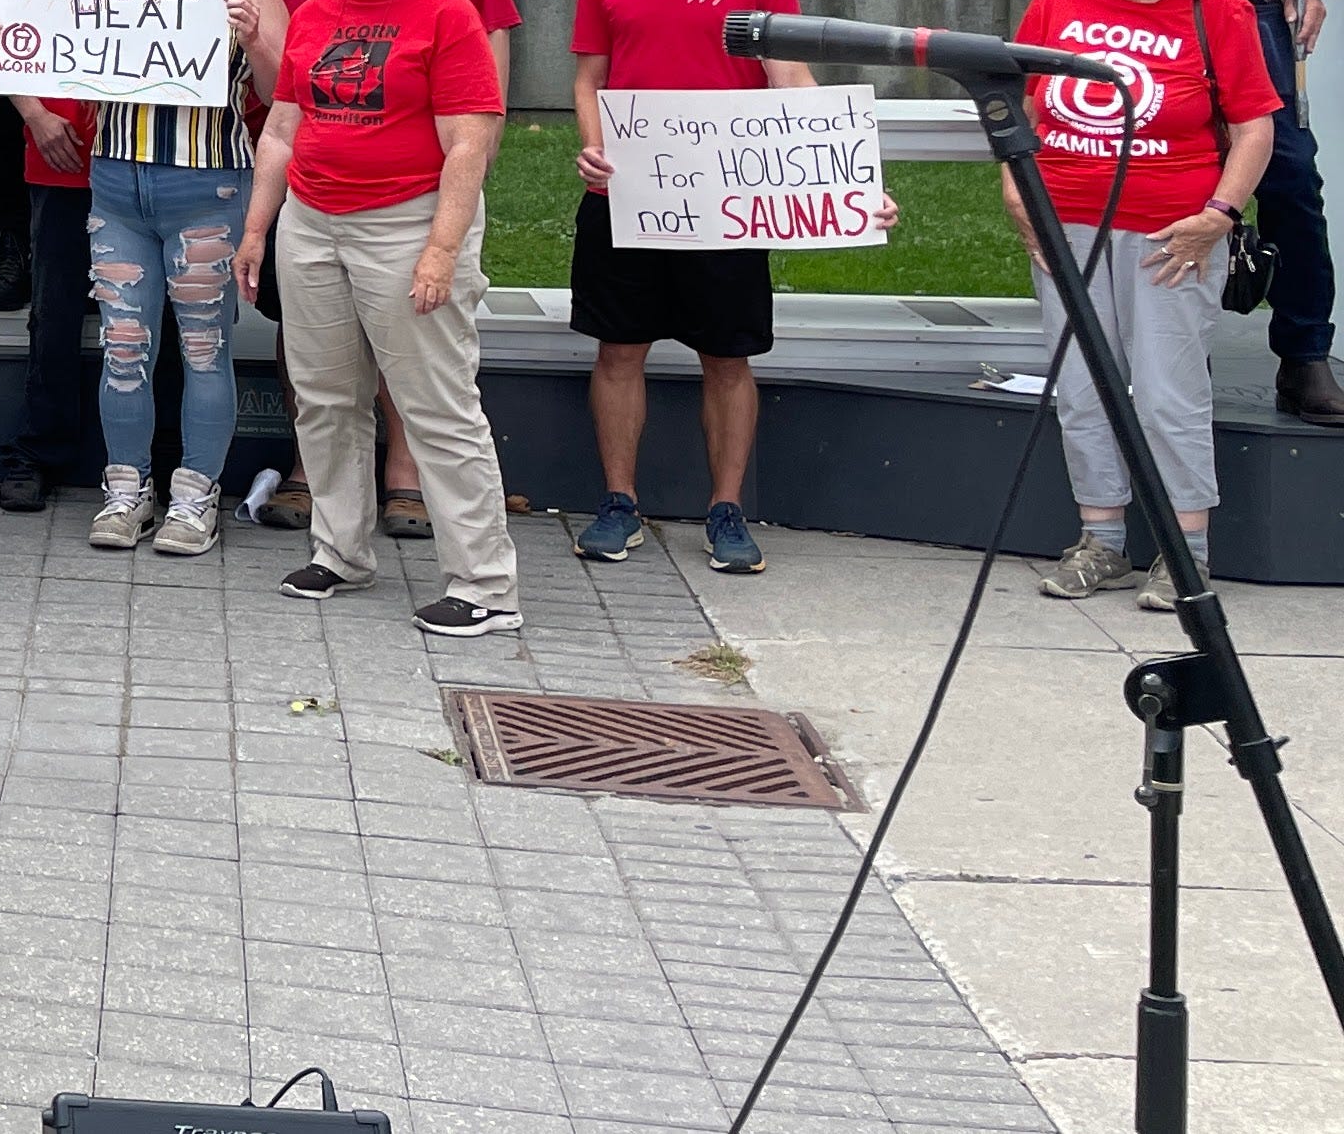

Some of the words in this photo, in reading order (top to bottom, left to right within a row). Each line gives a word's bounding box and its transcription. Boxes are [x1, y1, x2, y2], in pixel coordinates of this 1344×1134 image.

[334, 24, 401, 39] ACORN
[1059, 20, 1183, 61] ACORN
[52, 33, 221, 81] BYLAW
[601, 94, 649, 140] We
[664, 114, 718, 145] sign
[730, 95, 876, 138] contracts
[649, 153, 705, 189] for
[718, 139, 874, 188] HOUSING
[637, 198, 701, 233] not
[721, 191, 869, 240] SAUNAS
